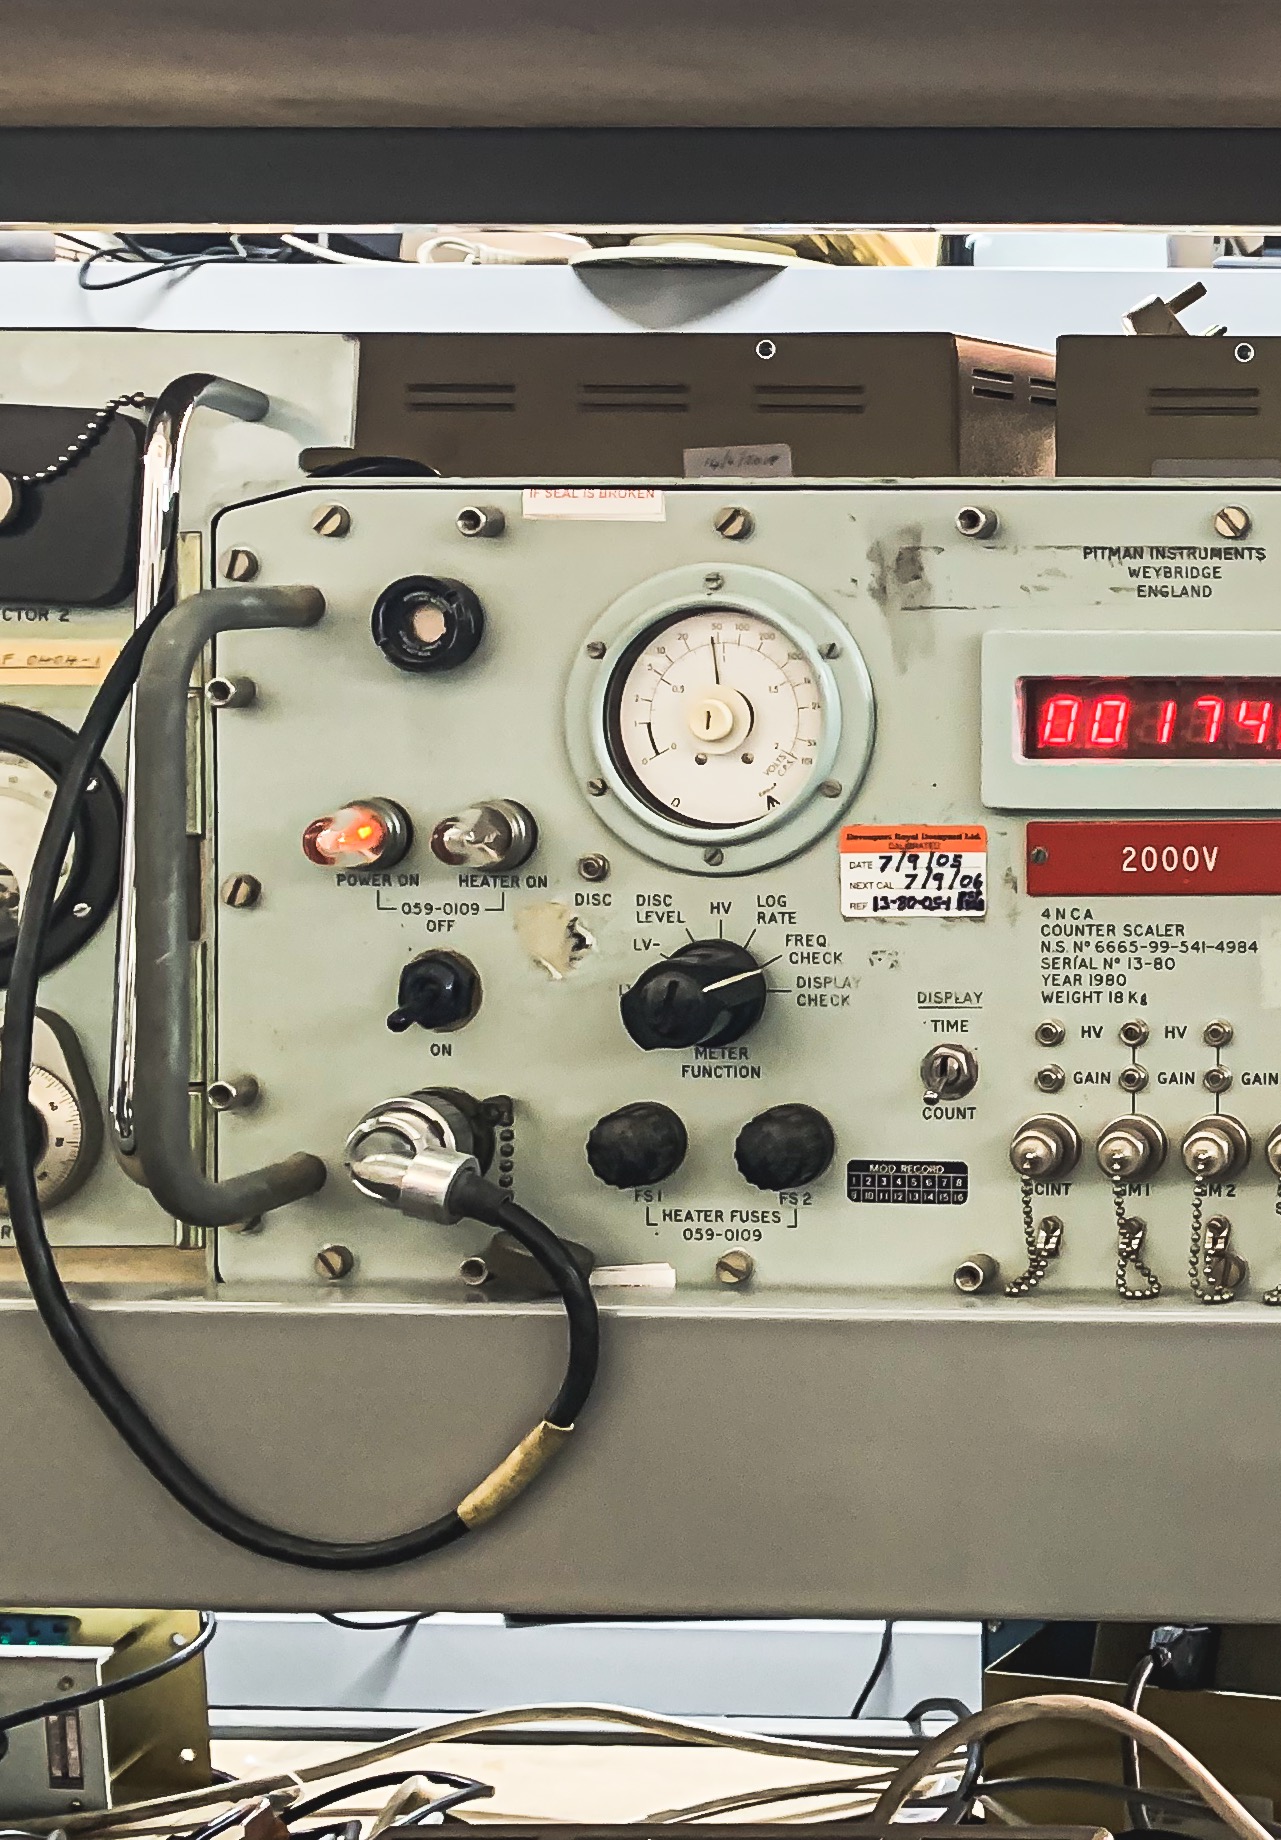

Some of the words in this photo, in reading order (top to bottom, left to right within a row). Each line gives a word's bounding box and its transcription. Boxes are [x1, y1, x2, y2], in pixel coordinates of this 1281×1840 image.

[546, 489, 580, 498] SEAL
[1083, 547, 1143, 560] PITMAN
[1150, 547, 1266, 561] INSTRUMENTS
[1128, 567, 1222, 579] WEYBRIDGE
[1137, 585, 1212, 597] ENGLAND
[59, 609, 69, 622] 2
[850, 861, 872, 869] DATE
[878, 851, 963, 873] 7/9/05
[1122, 846, 1218, 872] 2000V
[336, 874, 392, 886] POWER
[400, 874, 419, 886] ON
[459, 875, 520, 888] HEATER
[526, 875, 548, 888] ON
[905, 867, 983, 890] 7/9/06
[575, 894, 612, 906] DISC
[636, 894, 672, 907] DISC
[757, 895, 786, 908] LOG
[402, 902, 480, 915] 059-0109
[710, 902, 732, 914] HV
[636, 911, 686, 923] LEVEL
[757, 912, 796, 924] RATE
[426, 920, 455, 932] OFF
[1041, 924, 1116, 937] COUNTER
[1123, 924, 1185, 936] SCALER
[1095, 941, 1258, 953] 6665-99-541-4984
[789, 952, 843, 964] CHECK
[1041, 957, 1097, 970] SERIAL
[1128, 958, 1176, 970] 13-80
[796, 976, 861, 989] DISPLAY
[1042, 974, 1083, 986] YEAR
[1089, 974, 1127, 986] 1980
[796, 994, 850, 1007] CHECK
[918, 992, 983, 1003] DISPLAY
[1041, 991, 1103, 1003] WEIGHT
[931, 1020, 968, 1032] TIME
[1081, 1026, 1103, 1038] HV
[1165, 1026, 1187, 1039] HV
[430, 1044, 452, 1056] ON
[695, 1048, 748, 1060] METER
[682, 1066, 761, 1078] FUNCTION
[1073, 1072, 1111, 1084] GAIN
[1158, 1072, 1195, 1084] GAIN
[1241, 1073, 1279, 1085] GAIN
[923, 1107, 976, 1120] COUNT
[662, 1210, 724, 1223] HEATER
[730, 1210, 782, 1223] FUSES
[683, 1228, 762, 1241] 059-0109
